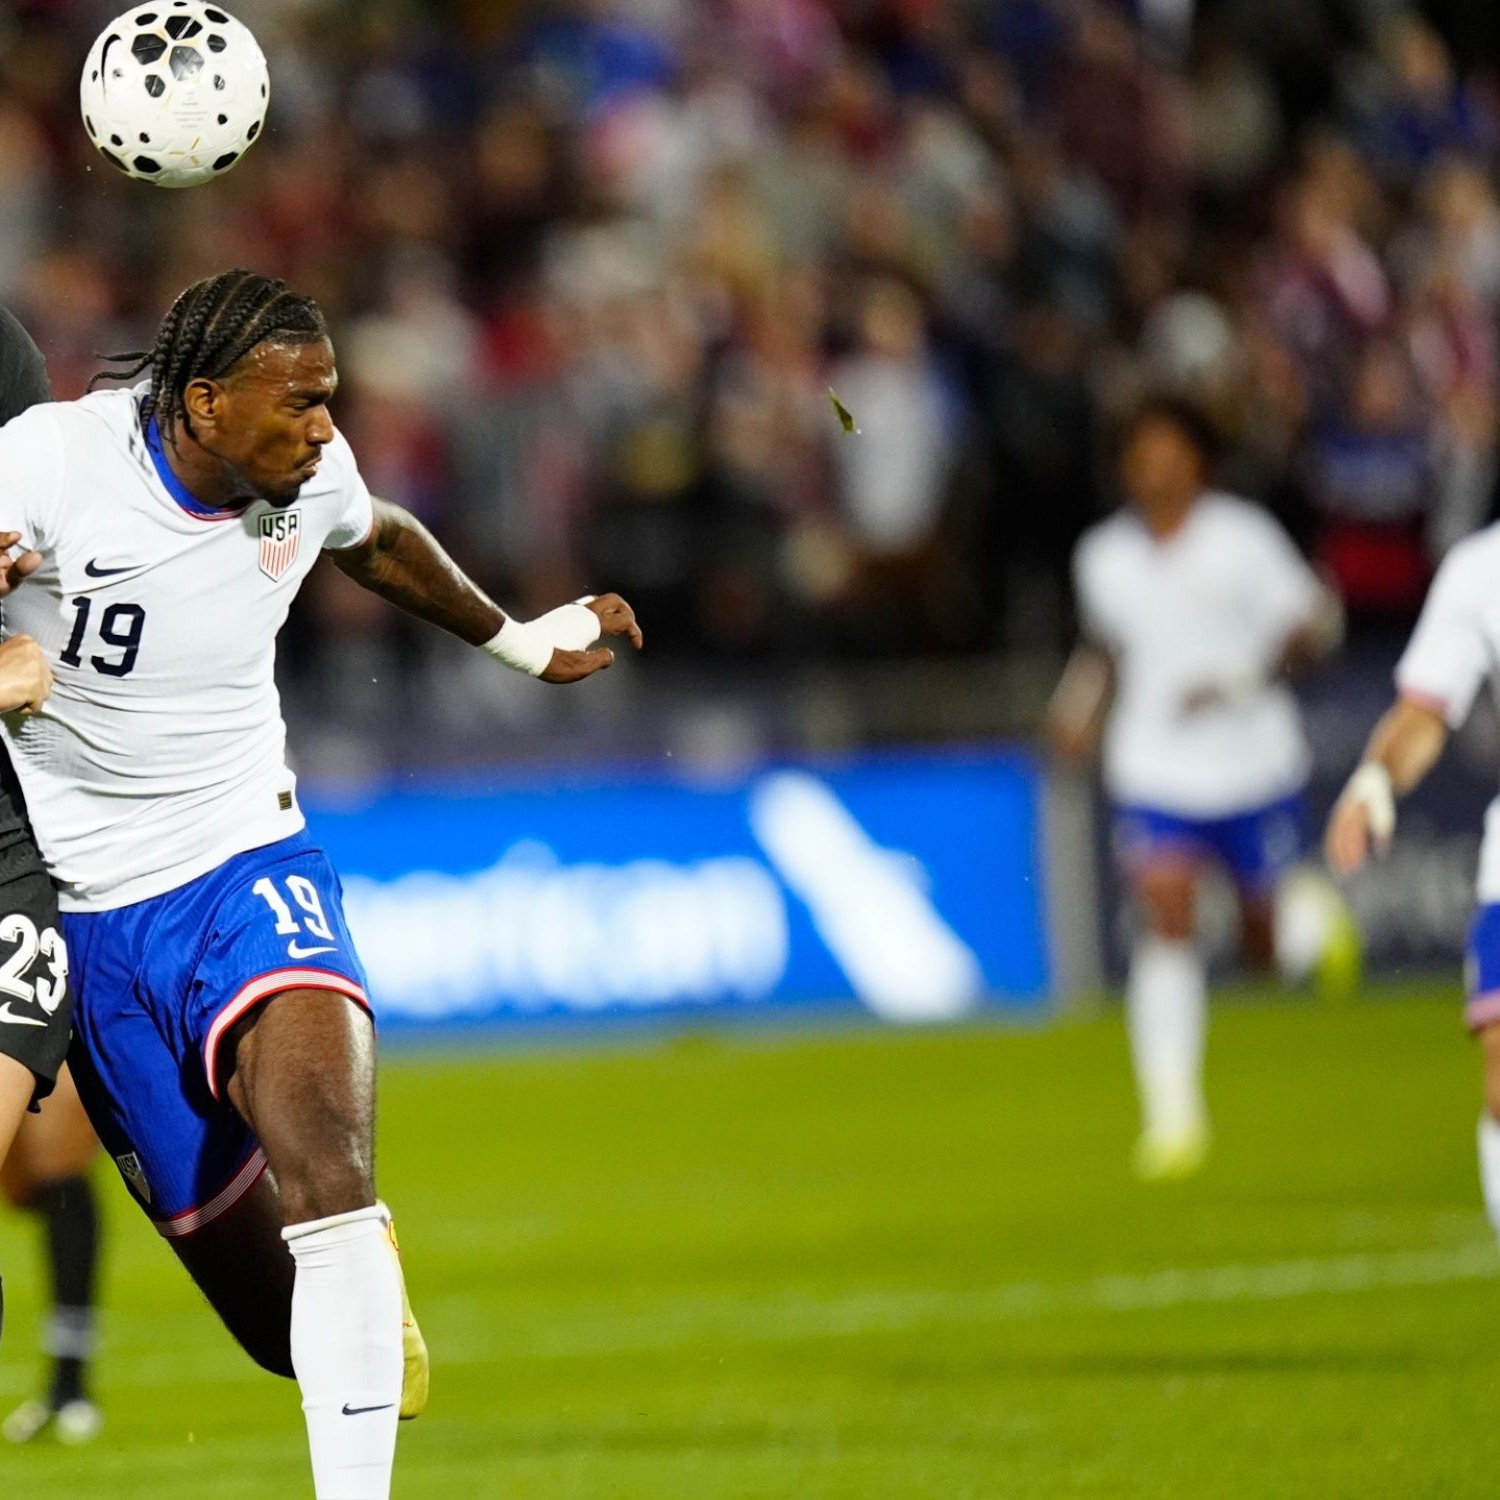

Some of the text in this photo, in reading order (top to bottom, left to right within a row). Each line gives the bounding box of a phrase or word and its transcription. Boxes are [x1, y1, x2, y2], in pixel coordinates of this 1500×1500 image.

[262, 514, 298, 542] USA
[59, 595, 146, 678] 19
[251, 874, 336, 941] 19
